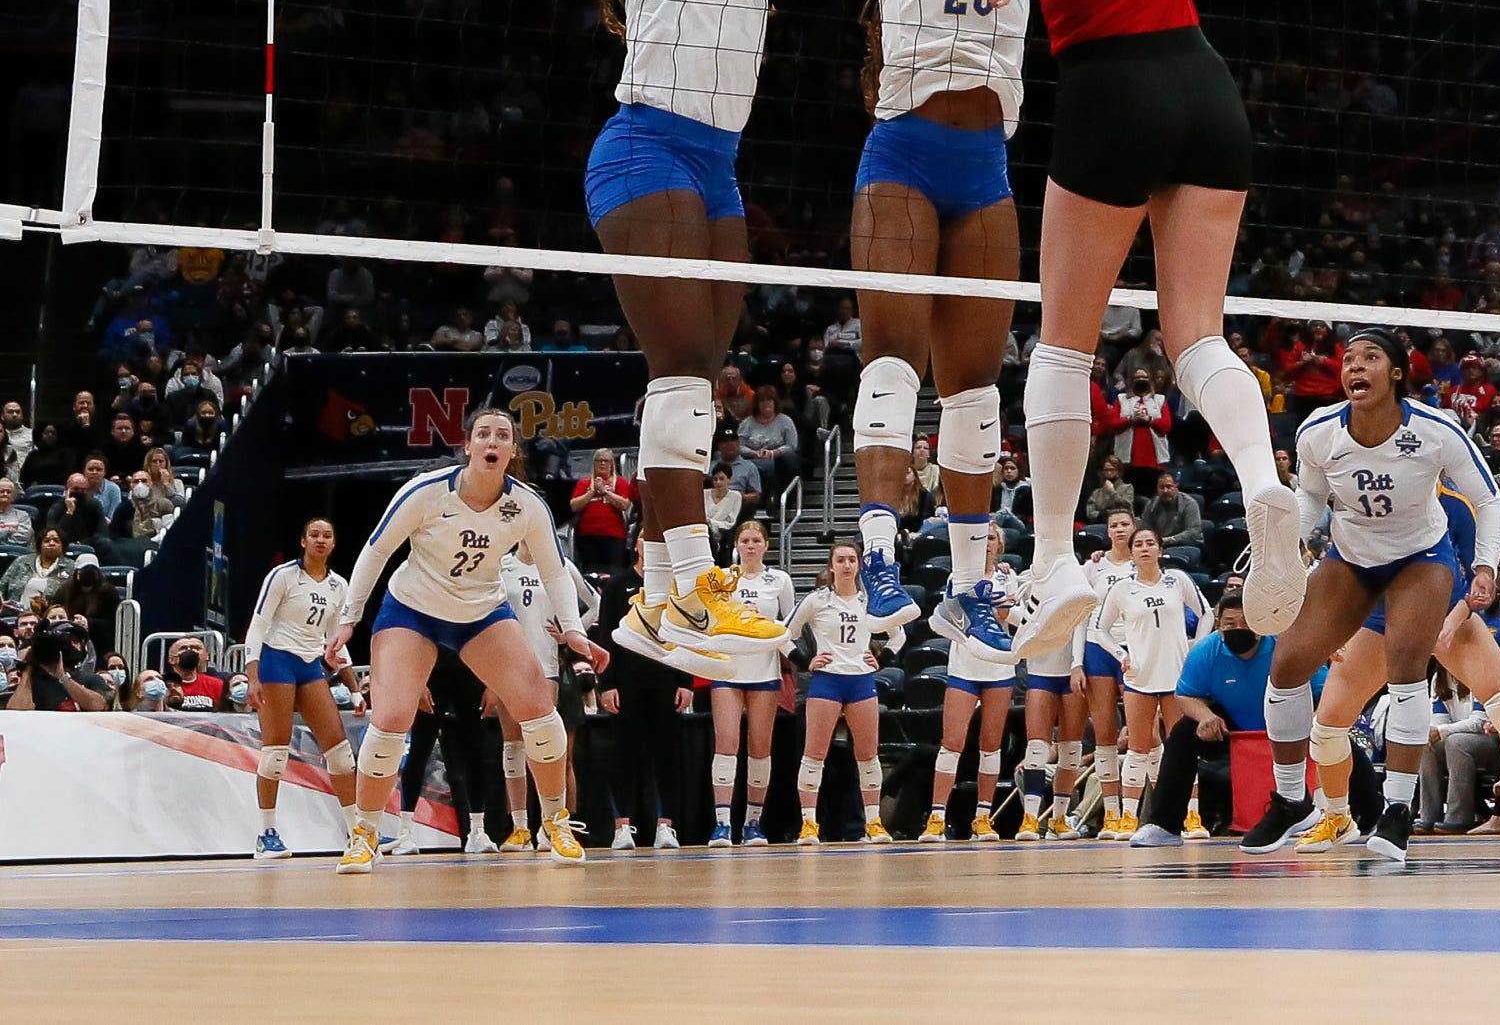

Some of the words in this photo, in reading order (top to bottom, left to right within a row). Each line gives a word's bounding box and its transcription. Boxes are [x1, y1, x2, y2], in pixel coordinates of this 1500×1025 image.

[407, 387, 469, 446] N
[509, 390, 596, 439] Pitt
[1352, 469, 1394, 491] Pitt
[1358, 494, 1393, 518] 13
[459, 529, 490, 549] Pitt
[450, 551, 485, 576] 23
[518, 576, 540, 587] Pitt
[309, 592, 327, 606] Pitt
[522, 588, 533, 607] 8
[739, 589, 759, 599] Pitt
[1143, 596, 1165, 608] Pitt
[306, 606, 325, 627] 21
[838, 611, 858, 623] Pitt
[1153, 608, 1160, 628] 1
[840, 625, 856, 644] 12
